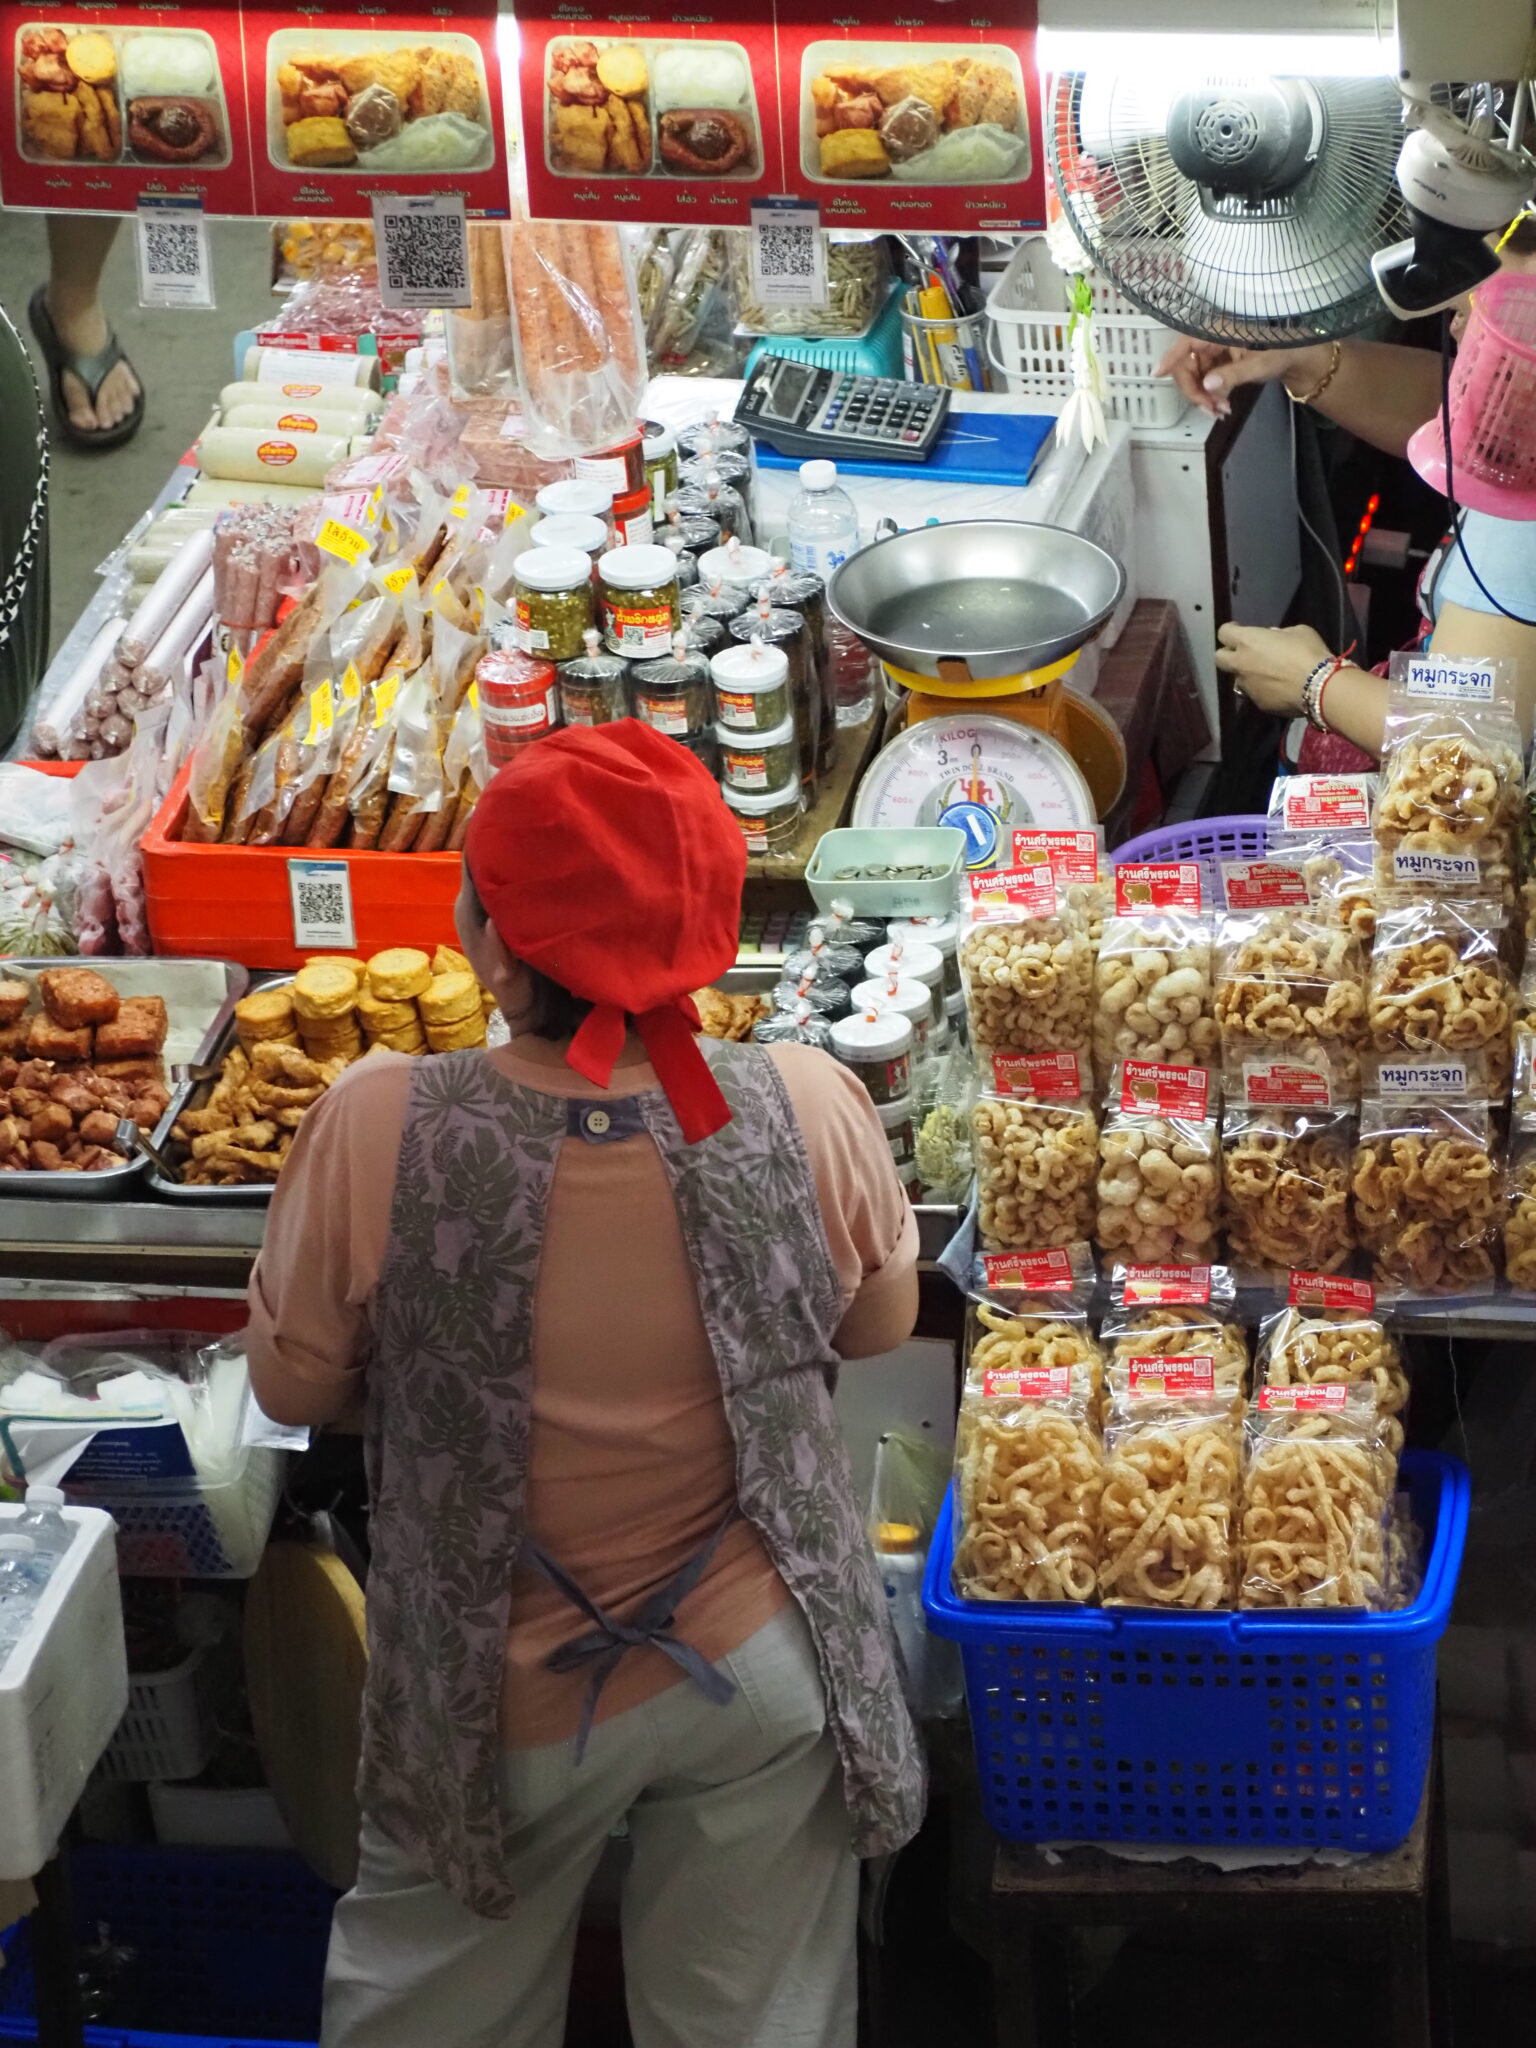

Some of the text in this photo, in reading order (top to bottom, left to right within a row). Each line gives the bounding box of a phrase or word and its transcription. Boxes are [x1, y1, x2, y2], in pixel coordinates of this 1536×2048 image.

[1411, 667, 1492, 688] หมูกระจก
[937, 749, 949, 765] 3
[961, 763, 985, 772] DOL
[1395, 855, 1475, 873] หมูกระจก
[972, 872, 1035, 889] ร้านศรีพรรณ
[1117, 866, 1180, 880] ร้านศรีพรรณ
[1125, 1062, 1188, 1082] ร้านศรีพรรณ
[1381, 1069, 1463, 1087] หมูกระจก
[1131, 1359, 1194, 1373] ร้านศรีพรรณ
